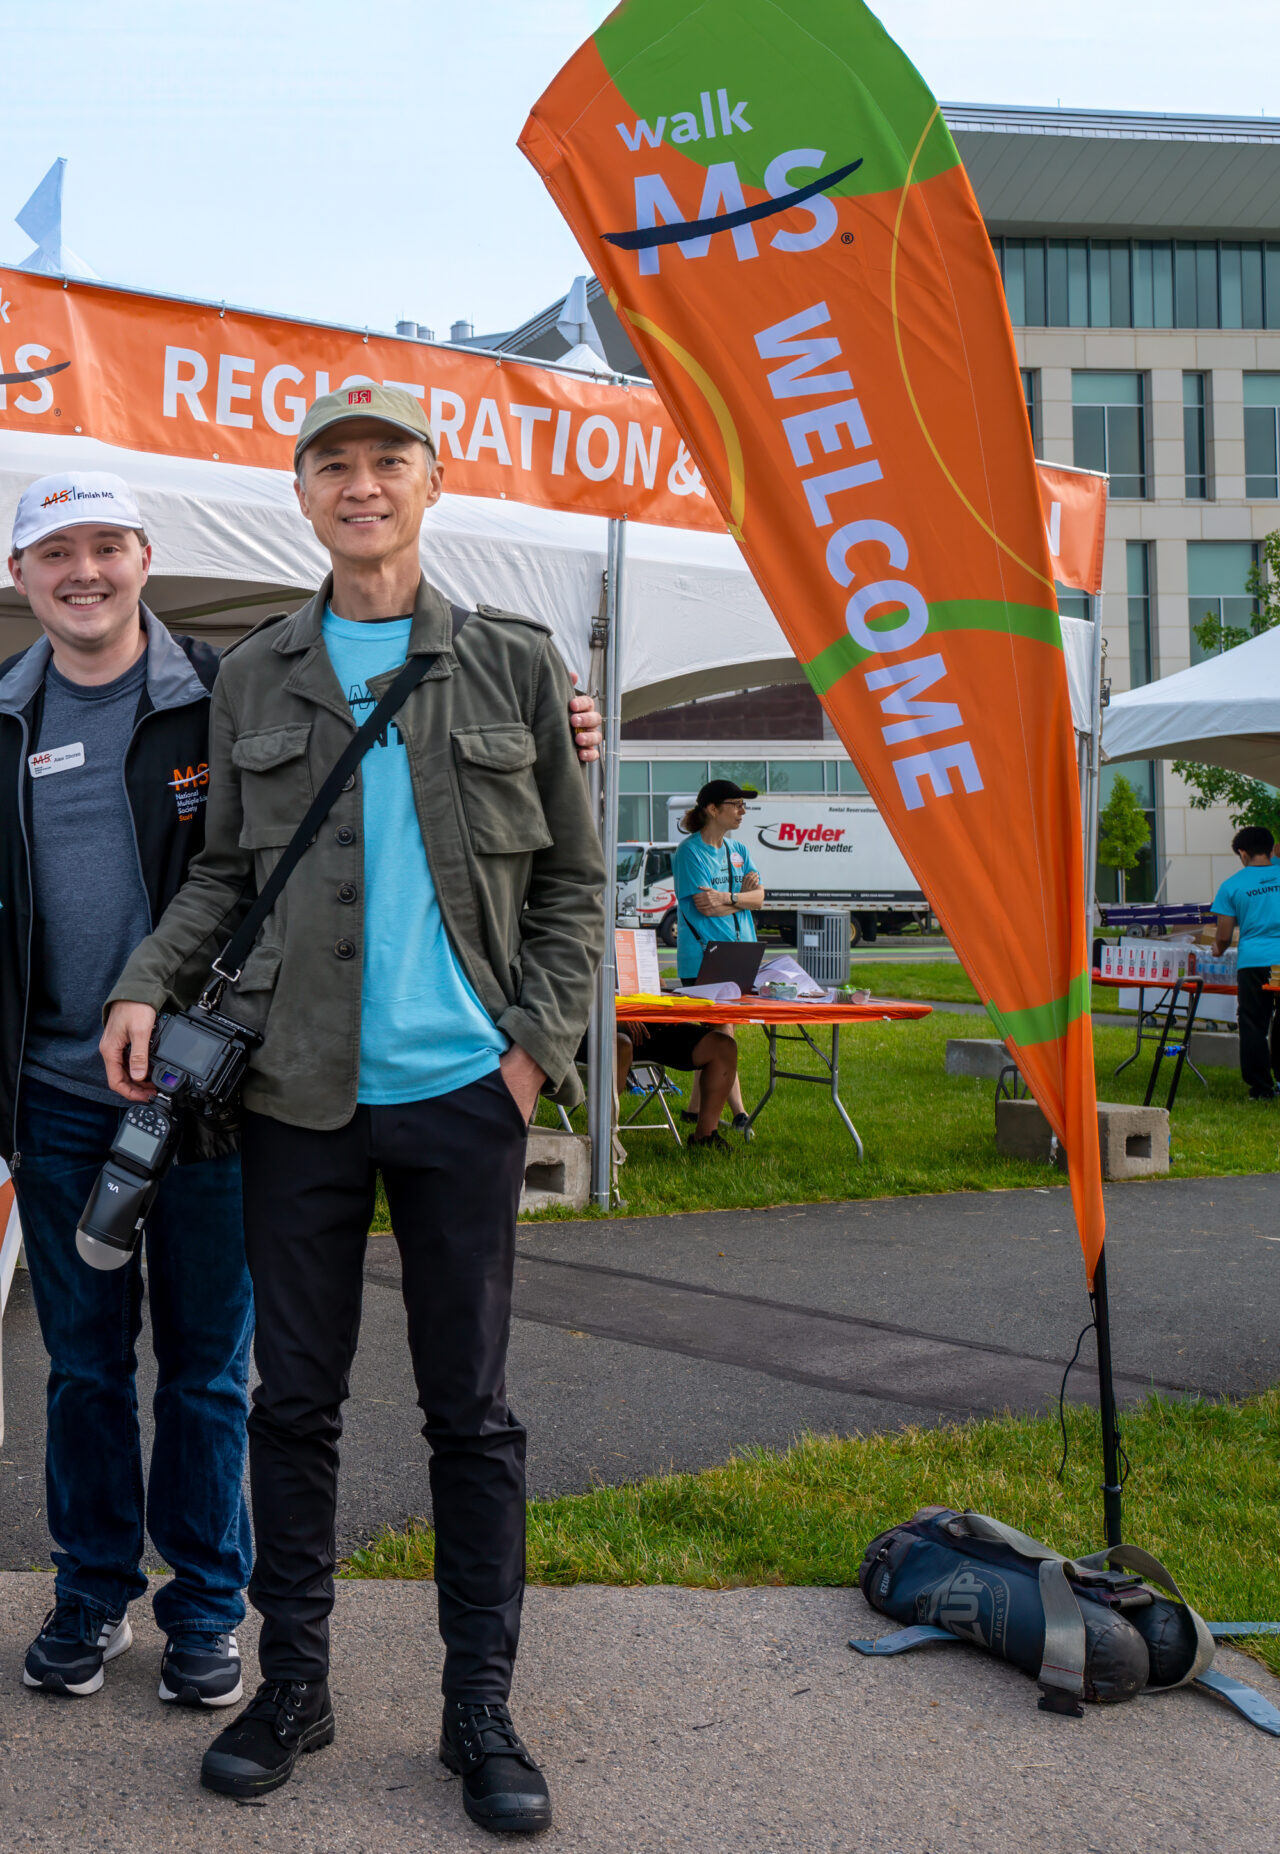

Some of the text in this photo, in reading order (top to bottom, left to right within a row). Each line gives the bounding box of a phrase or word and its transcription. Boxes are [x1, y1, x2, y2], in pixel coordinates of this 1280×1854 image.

[615, 88, 753, 152] walk
[633, 148, 839, 276] MS
[162, 345, 663, 492] REGRATION
[77, 491, 101, 500] Finish
[753, 300, 985, 812] WELCOME
[778, 823, 846, 846] Ryder
[803, 842, 824, 853] Ever
